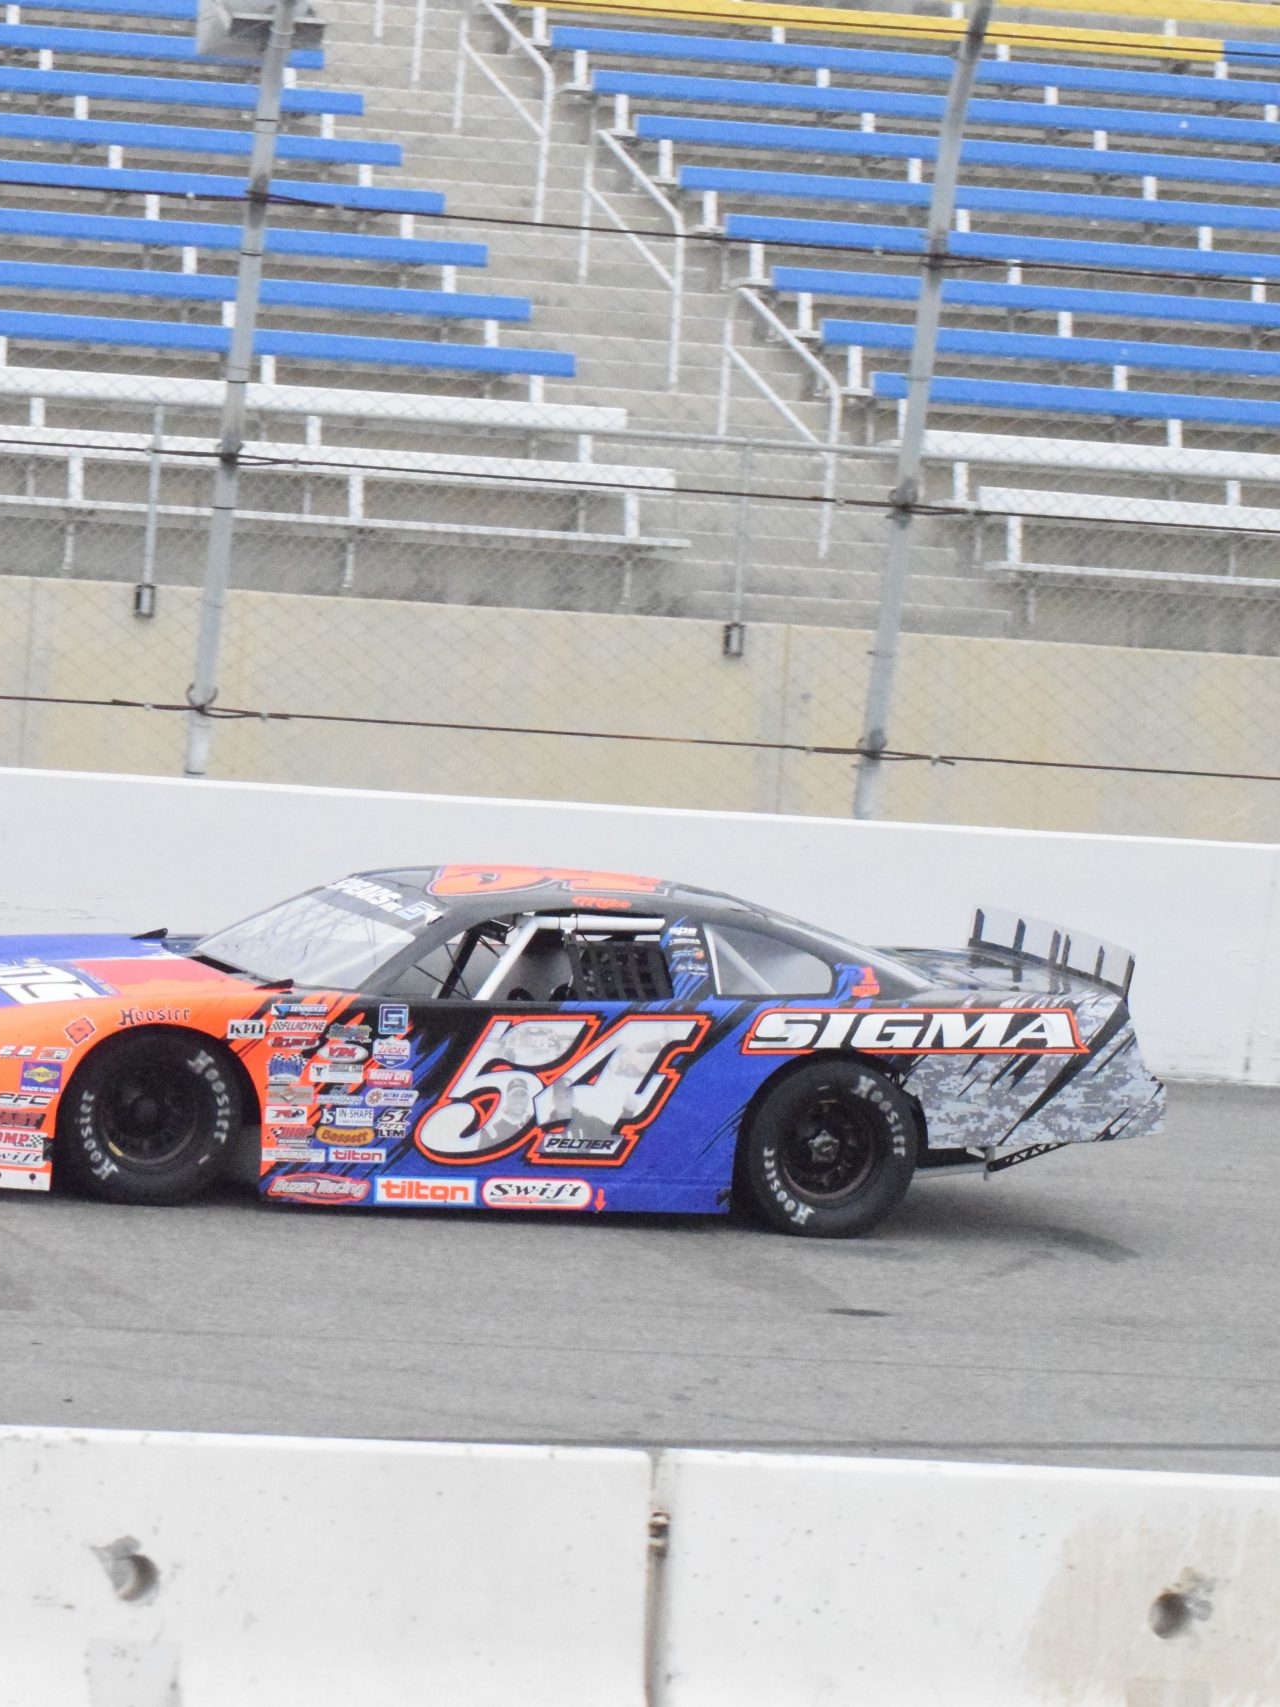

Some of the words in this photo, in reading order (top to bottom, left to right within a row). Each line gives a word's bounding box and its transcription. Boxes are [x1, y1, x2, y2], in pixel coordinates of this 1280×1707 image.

[118, 1007, 191, 1026] Hoosier
[230, 1023, 264, 1034] KHI
[282, 1021, 326, 1032] FLUIDYNE
[747, 1012, 1078, 1050] SIGMA
[418, 1017, 705, 1160] 54
[338, 1110, 373, 1119] IN-SHAPE
[379, 1110, 410, 1122] 51
[321, 1129, 369, 1143] Bassett
[545, 1138, 616, 1151] PELTIER
[332, 1150, 383, 1161] tilton
[381, 1180, 470, 1201] tilton
[489, 1182, 584, 1200] Swift
